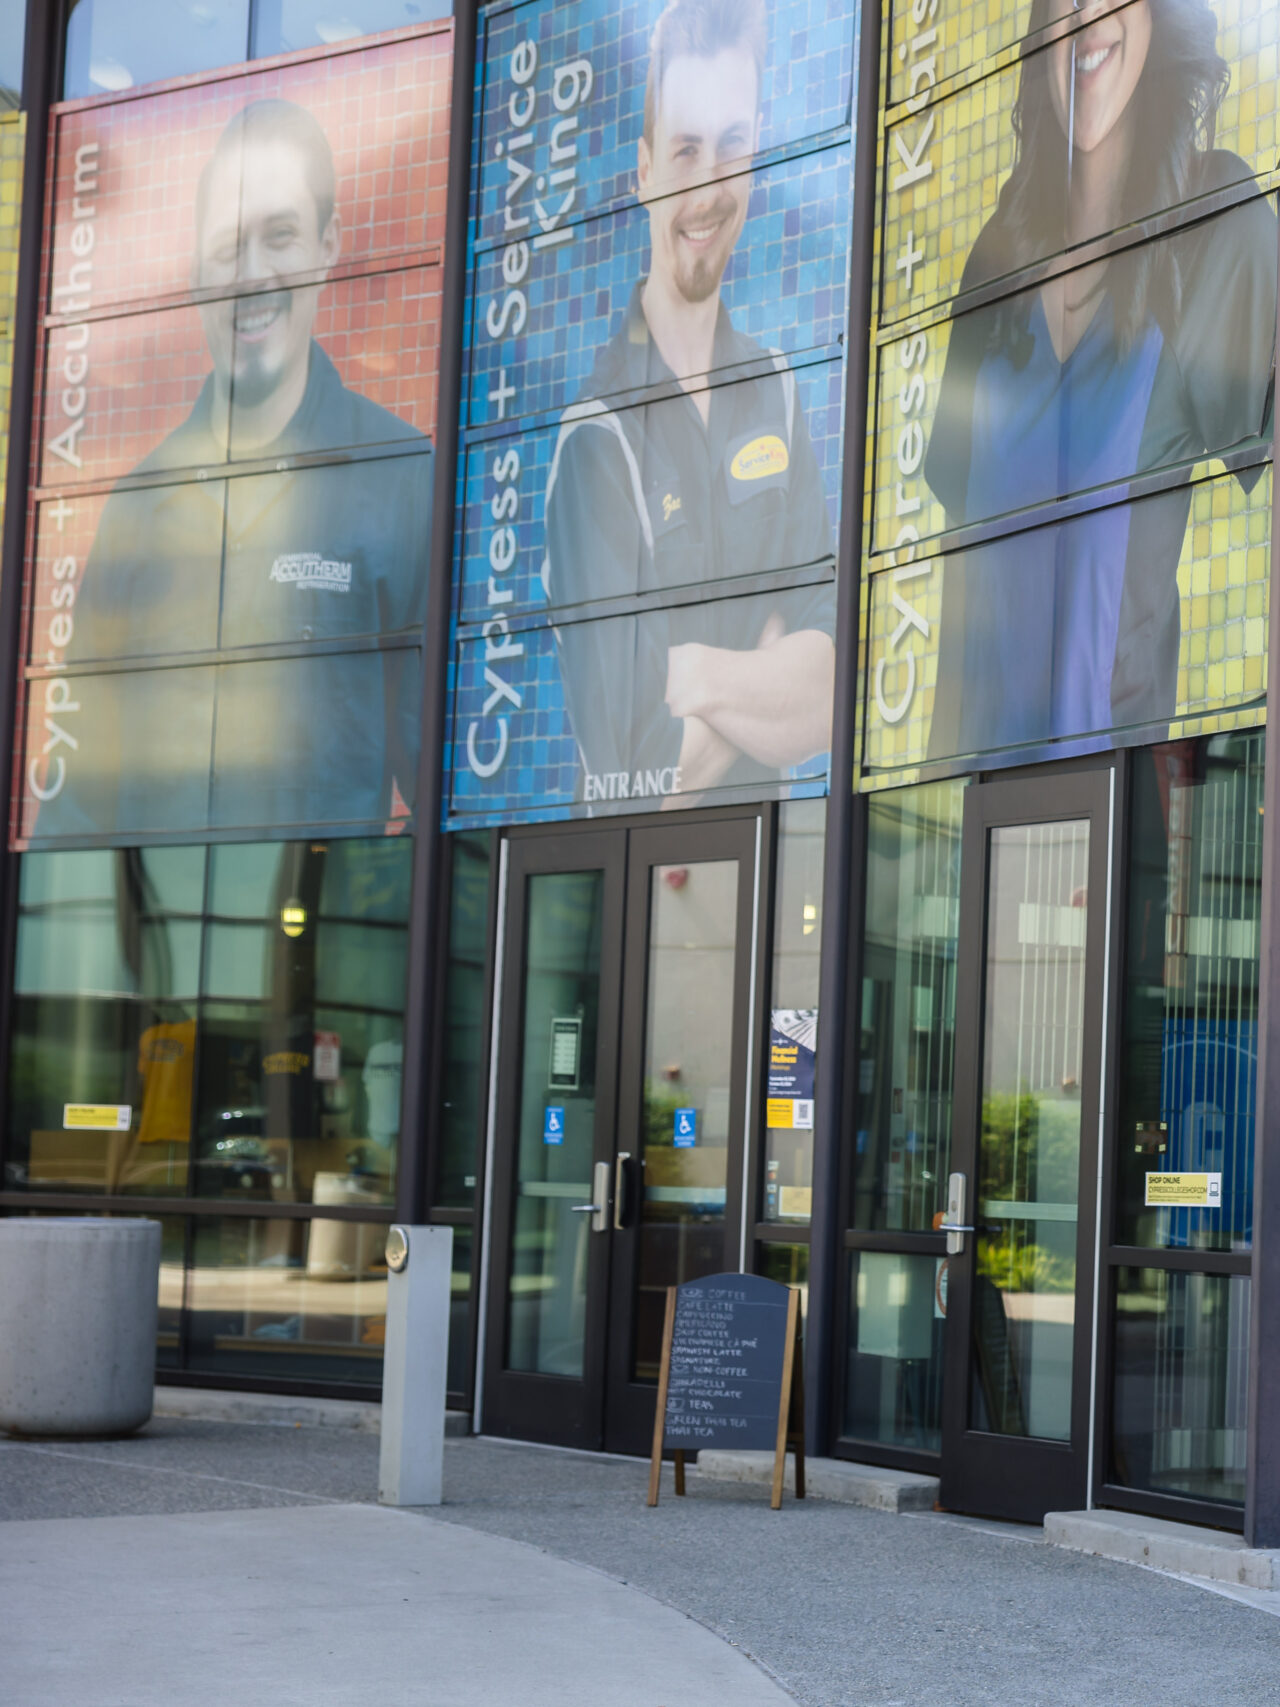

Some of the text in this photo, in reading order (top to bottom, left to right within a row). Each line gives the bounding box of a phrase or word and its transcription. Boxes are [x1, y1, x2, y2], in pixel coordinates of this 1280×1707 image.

[533, 58, 593, 250] King
[48, 142, 98, 468] Accutherm
[896, 230, 923, 289] +
[466, 39, 537, 778] Cypress + Service
[269, 559, 352, 583] ACCUTHERM
[876, 325, 931, 724] Cypress
[28, 555, 81, 801] Cypress
[583, 766, 682, 801] ENTRANCE
[689, 1400, 714, 1411] TEAS
